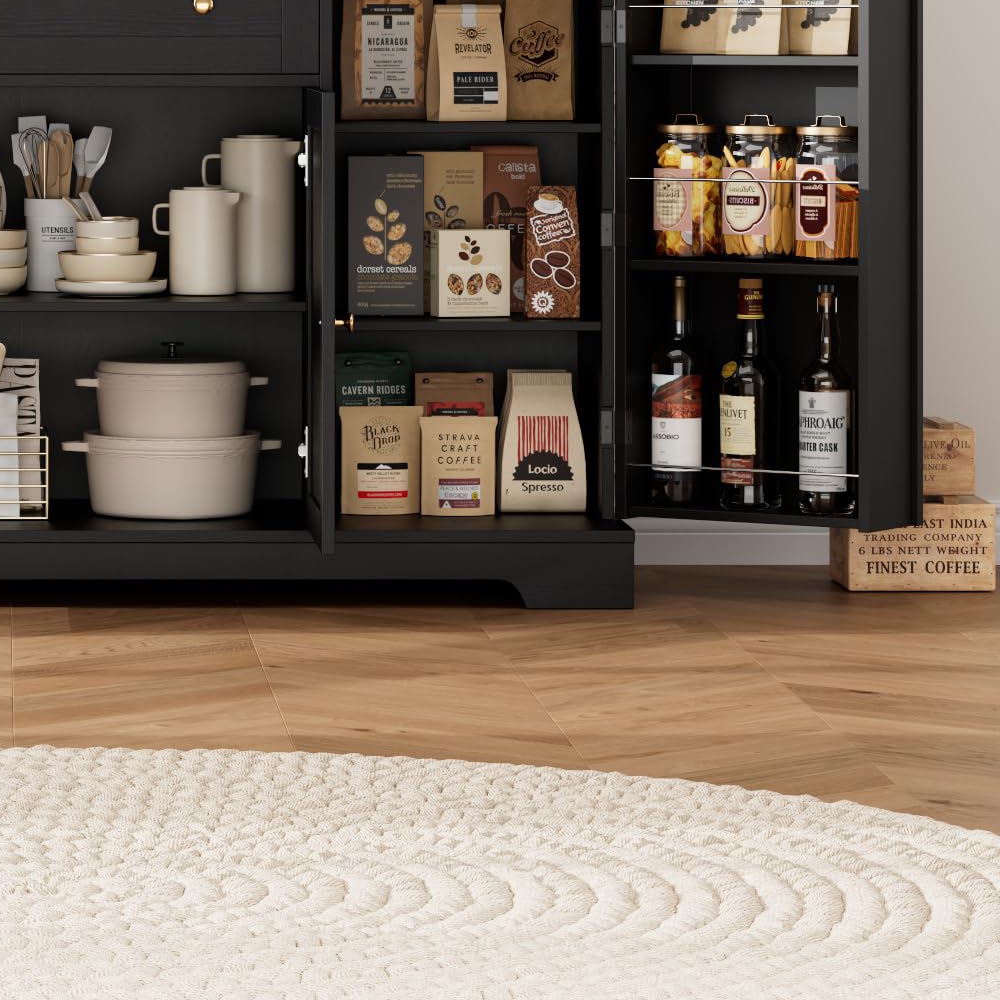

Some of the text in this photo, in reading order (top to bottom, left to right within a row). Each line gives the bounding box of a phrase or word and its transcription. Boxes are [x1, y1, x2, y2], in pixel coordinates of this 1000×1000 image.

[368, 38, 408, 46] NICARAGUA
[510, 30, 565, 56] Coffee
[455, 43, 491, 55] REVELATOR
[357, 265, 416, 273] dorset cereals
[342, 385, 406, 395] CAVERN RIDGES
[365, 425, 400, 443] BLACK
[724, 428, 731, 437] 15
[819, 442, 838, 452] CASK
[951, 438, 970, 448] OIL
[528, 464, 557, 474] Locio
[522, 482, 563, 494] Spresso
[950, 519, 987, 528] INDIA
[871, 547, 892, 555] LBS
[867, 561, 980, 574] FINEST COFFEE
